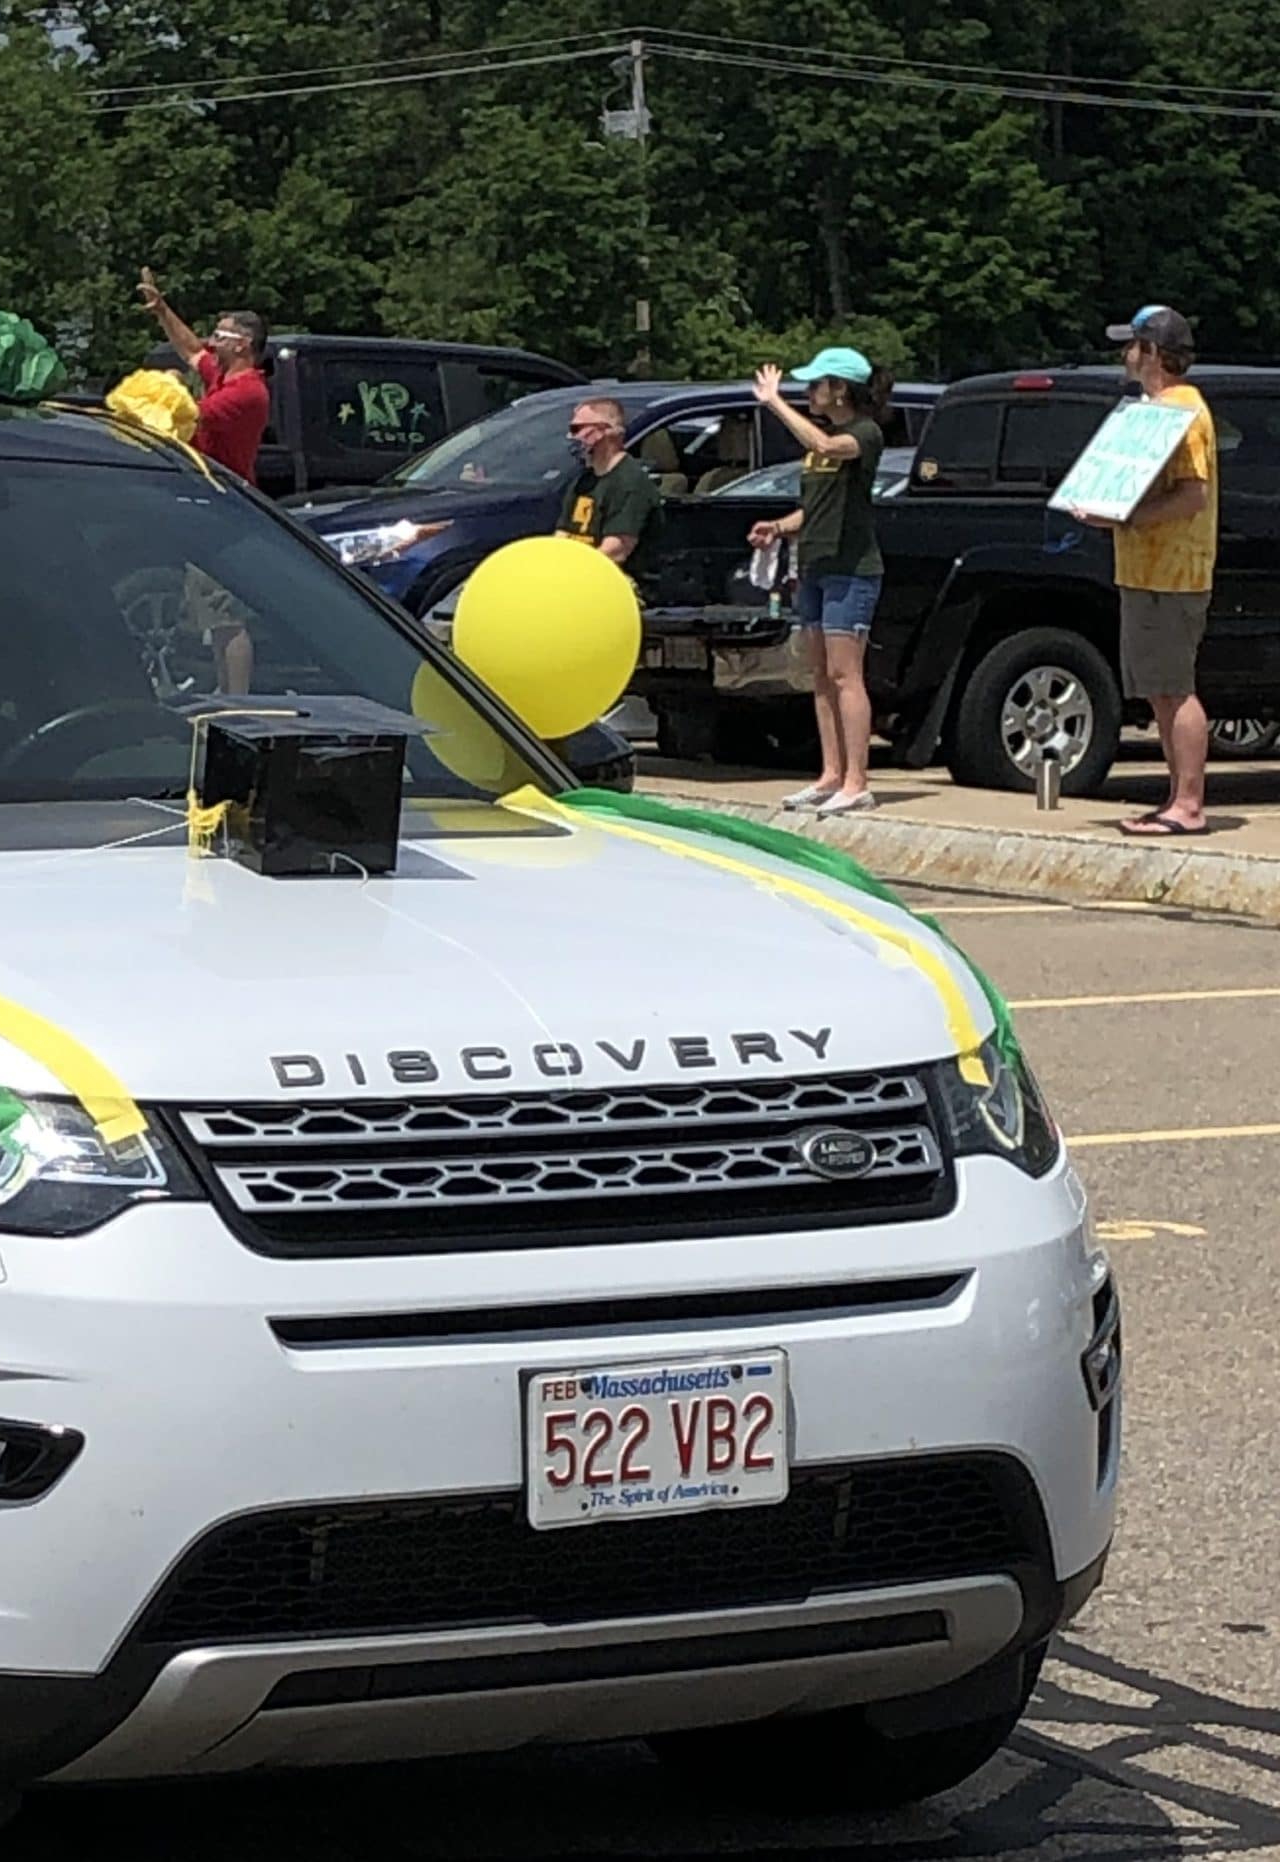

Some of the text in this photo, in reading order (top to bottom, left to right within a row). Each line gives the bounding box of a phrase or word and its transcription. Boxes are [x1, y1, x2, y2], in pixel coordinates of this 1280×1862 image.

[357, 381, 410, 427] KP
[269, 1027, 832, 1088] DISCOVERY
[542, 1366, 730, 1401] FEB Massachusetts
[543, 1391, 776, 1488] 522 VB2
[590, 1481, 730, 1508] The Spirit of America
